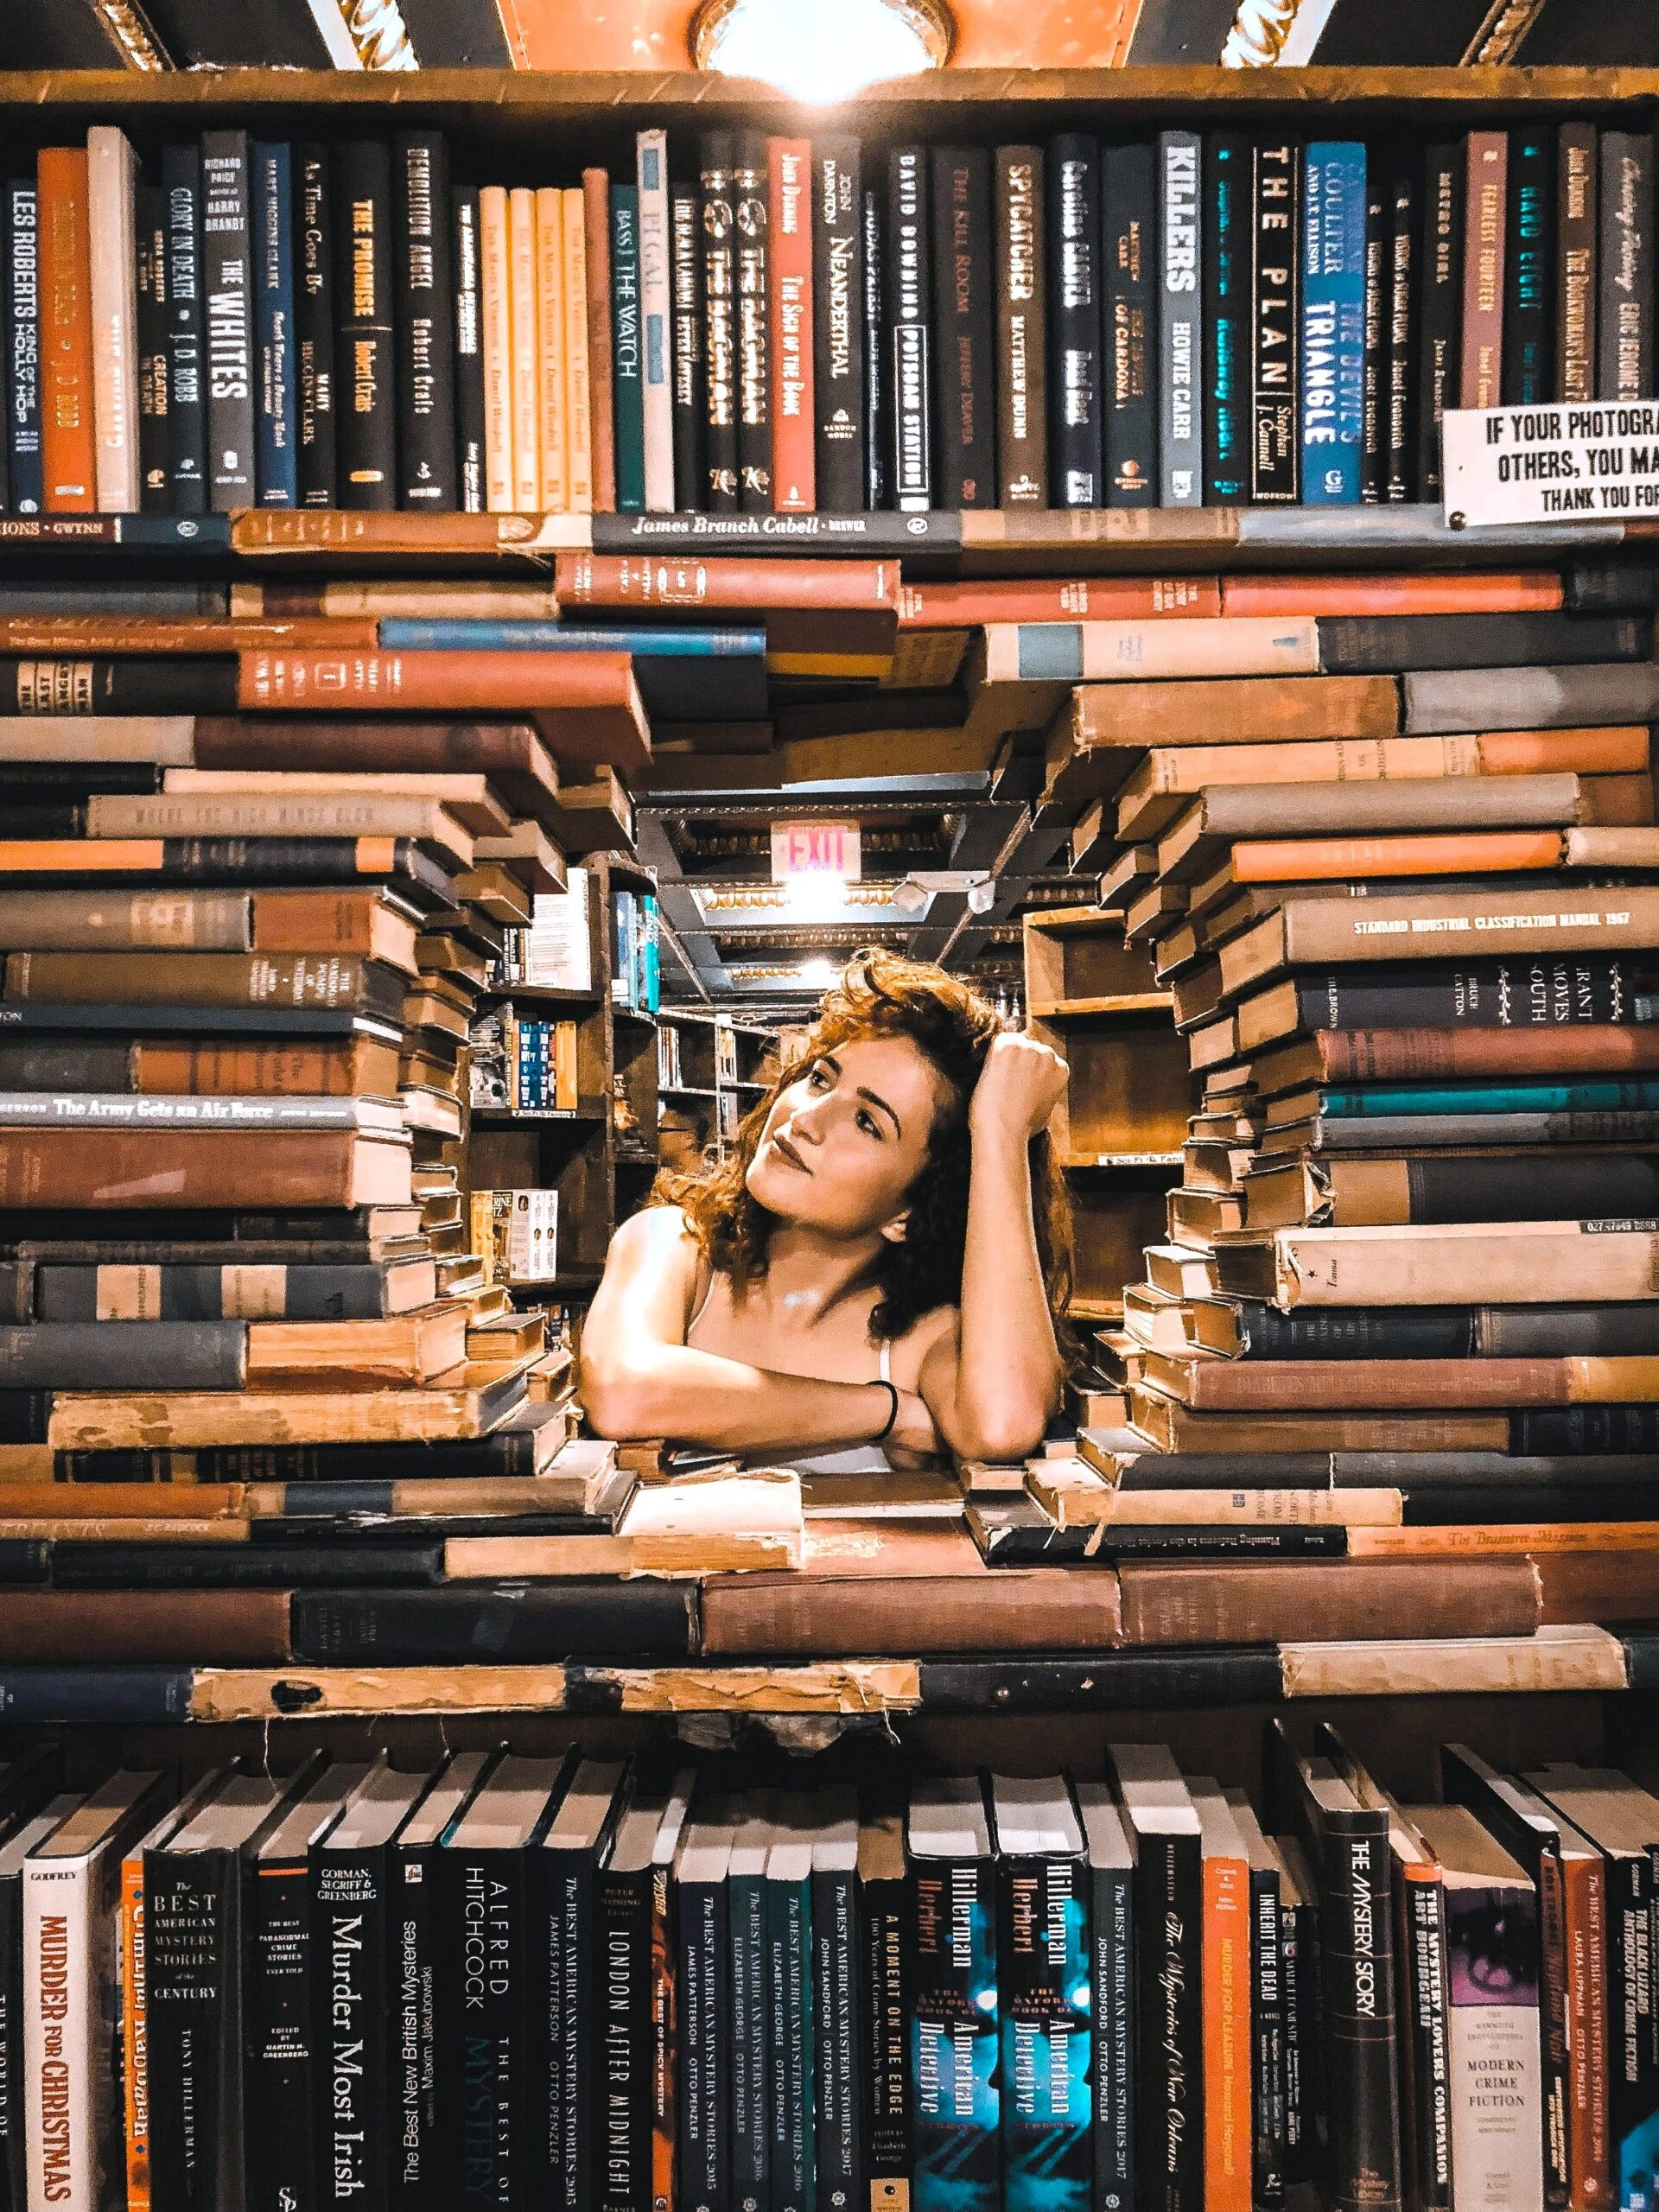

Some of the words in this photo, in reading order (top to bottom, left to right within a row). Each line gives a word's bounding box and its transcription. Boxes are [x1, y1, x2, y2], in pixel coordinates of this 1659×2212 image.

[204, 158, 241, 169] RICHARD
[211, 173, 235, 182] PRICE
[781, 155, 802, 183] JOHN
[207, 200, 241, 214] HARRY
[407, 149, 430, 235] DEMOLITION
[823, 161, 836, 224] DARNTON
[840, 173, 851, 211] JOHN
[900, 156, 917, 215] DAVID
[1262, 147, 1289, 229] THE
[13, 191, 36, 228] LES
[170, 188, 192, 232] GLORY
[206, 219, 244, 231] BRANDT
[353, 200, 373, 233] THE
[617, 210, 632, 245] BASS
[782, 186, 802, 232] DUNNING
[1166, 146, 1196, 292] KILLERS
[1323, 162, 1344, 275] COULTER
[172, 236, 193, 250] IN
[1007, 164, 1034, 301] SPYCATCHER
[14, 232, 37, 317] ROBERTS
[172, 256, 194, 299] DEATH
[221, 259, 243, 283] THE
[353, 238, 374, 316] PROMISE
[410, 245, 433, 289] ANGEL
[617, 265, 634, 299] THE
[782, 276, 804, 301] THE
[901, 226, 918, 319] DOWNING
[782, 304, 804, 333] SIGN
[830, 237, 854, 378] NEANDERTHAL
[1261, 268, 1288, 384] PLAN
[15, 324, 26, 378] HOLLY
[26, 324, 36, 362] KING
[209, 292, 246, 398] WHITES
[355, 341, 376, 379] Robert
[413, 319, 432, 369] Robert
[618, 305, 636, 377] WATCH
[784, 336, 800, 351] OF
[1173, 322, 1191, 385] HOWIE
[154, 355, 167, 415] CREATION
[784, 355, 802, 378] THE
[903, 330, 918, 409] POTSDAM
[1304, 301, 1336, 445] TRIANGLE
[16, 385, 27, 423] HOP
[27, 385, 35, 408] THE
[355, 382, 376, 411] Crais
[414, 376, 433, 415] Crais
[783, 381, 804, 416] BOOK
[1173, 390, 1191, 439] CARR
[1258, 419, 1274, 471] Cannell
[1274, 405, 1292, 456] Stephen
[1486, 416, 1504, 444] IF
[1512, 412, 1561, 442] YOUR
[904, 415, 920, 485] STATION
[1498, 450, 1580, 482] OTHERS,
[1587, 448, 1624, 475] YOU
[1541, 487, 1594, 512] THANK
[1600, 486, 1630, 508] YOU
[53, 522, 103, 534] GWYNN
[632, 517, 690, 535] James
[693, 517, 758, 534] Branch
[787, 826, 848, 872] EXIT
[1354, 919, 1408, 934] STANDARD
[1411, 918, 1471, 932] INDUSTRIAL
[1474, 915, 1557, 931] CLASSIFICATION
[1560, 912, 1601, 927] MANUAL
[1605, 912, 1630, 925] 1967
[1554, 963, 1569, 1021] MOVES
[1575, 968, 1593, 1020] RANT
[53, 1098, 85, 1116] The
[86, 1100, 134, 1121] Army
[137, 1100, 173, 1118] Gets
[175, 1105, 197, 1118] an
[200, 1101, 229, 1118] Air
[232, 1101, 273, 1118] Force
[321, 1868, 372, 1879] GORMAN,
[1351, 1840, 1370, 1869] THE
[30, 1872, 77, 1881] GODFREY
[317, 1890, 377, 1901] GREENBERG
[321, 1879, 360, 1891] SEGRIFF
[362, 1879, 372, 1891] &
[154, 1894, 216, 1911] BEST
[154, 1917, 215, 1928] AMERICAN
[951, 1868, 976, 1967] Hillerman
[1046, 1865, 1072, 1965] Hillerman
[1259, 1893, 1275, 1941] INHERIT
[1352, 1872, 1372, 1955] MYSTERY
[155, 1935, 215, 1946] MYSTERY
[466, 1867, 485, 2009] HITCHCOCK
[490, 1882, 508, 1994] ALFRED
[550, 1915, 560, 1956] JAMES
[820, 1938, 830, 1967] JOHN
[1260, 1944, 1276, 1966] THE
[41, 1915, 68, 2021] MURDER
[154, 1953, 216, 1965] STORIES
[332, 1915, 363, 2030] Murder
[401, 1921, 420, 2000] Mysteries
[609, 1932, 630, 2010] LONDON
[887, 1933, 900, 1998] MOMENT
[154, 1987, 217, 1999] CENTURY
[421, 1967, 435, 2042] Jakubowski
[550, 1962, 560, 2041] PATTERSON
[822, 1970, 831, 2028] SANDFORD
[1261, 1970, 1277, 2000] DEAD
[1355, 1961, 1376, 2016] STORY
[401, 2005, 418, 2060] British
[887, 2006, 900, 2026] ON
[44, 2025, 64, 2057] FOR
[605, 2024, 630, 2080] AFTER
[823, 2040, 832, 2070] OTTO
[888, 2037, 902, 2064] THE
[334, 2039, 364, 2120] Most
[403, 2065, 418, 2103] New
[421, 2045, 434, 2088] Maxim
[550, 2061, 560, 2101] OTTO
[918, 2021, 945, 2113] Detective
[953, 2021, 979, 2115] American
[1014, 2021, 1040, 2113] Detective
[1049, 2020, 1076, 2113] American
[1468, 2059, 1524, 2072] MODERN
[1475, 2077, 1518, 2089] CRIME
[823, 2074, 833, 2120] PENZLER
[888, 2075, 903, 2115] EDGE
[1469, 2094, 1525, 2107] FICTION
[41, 2060, 72, 2202] CHRISTMAS
[403, 2110, 419, 2147] Best
[550, 2106, 560, 2164] PENZLER
[608, 2095, 630, 2194] MIDNIGHT
[334, 2131, 365, 2198] Irish
[404, 2152, 419, 2183] The
